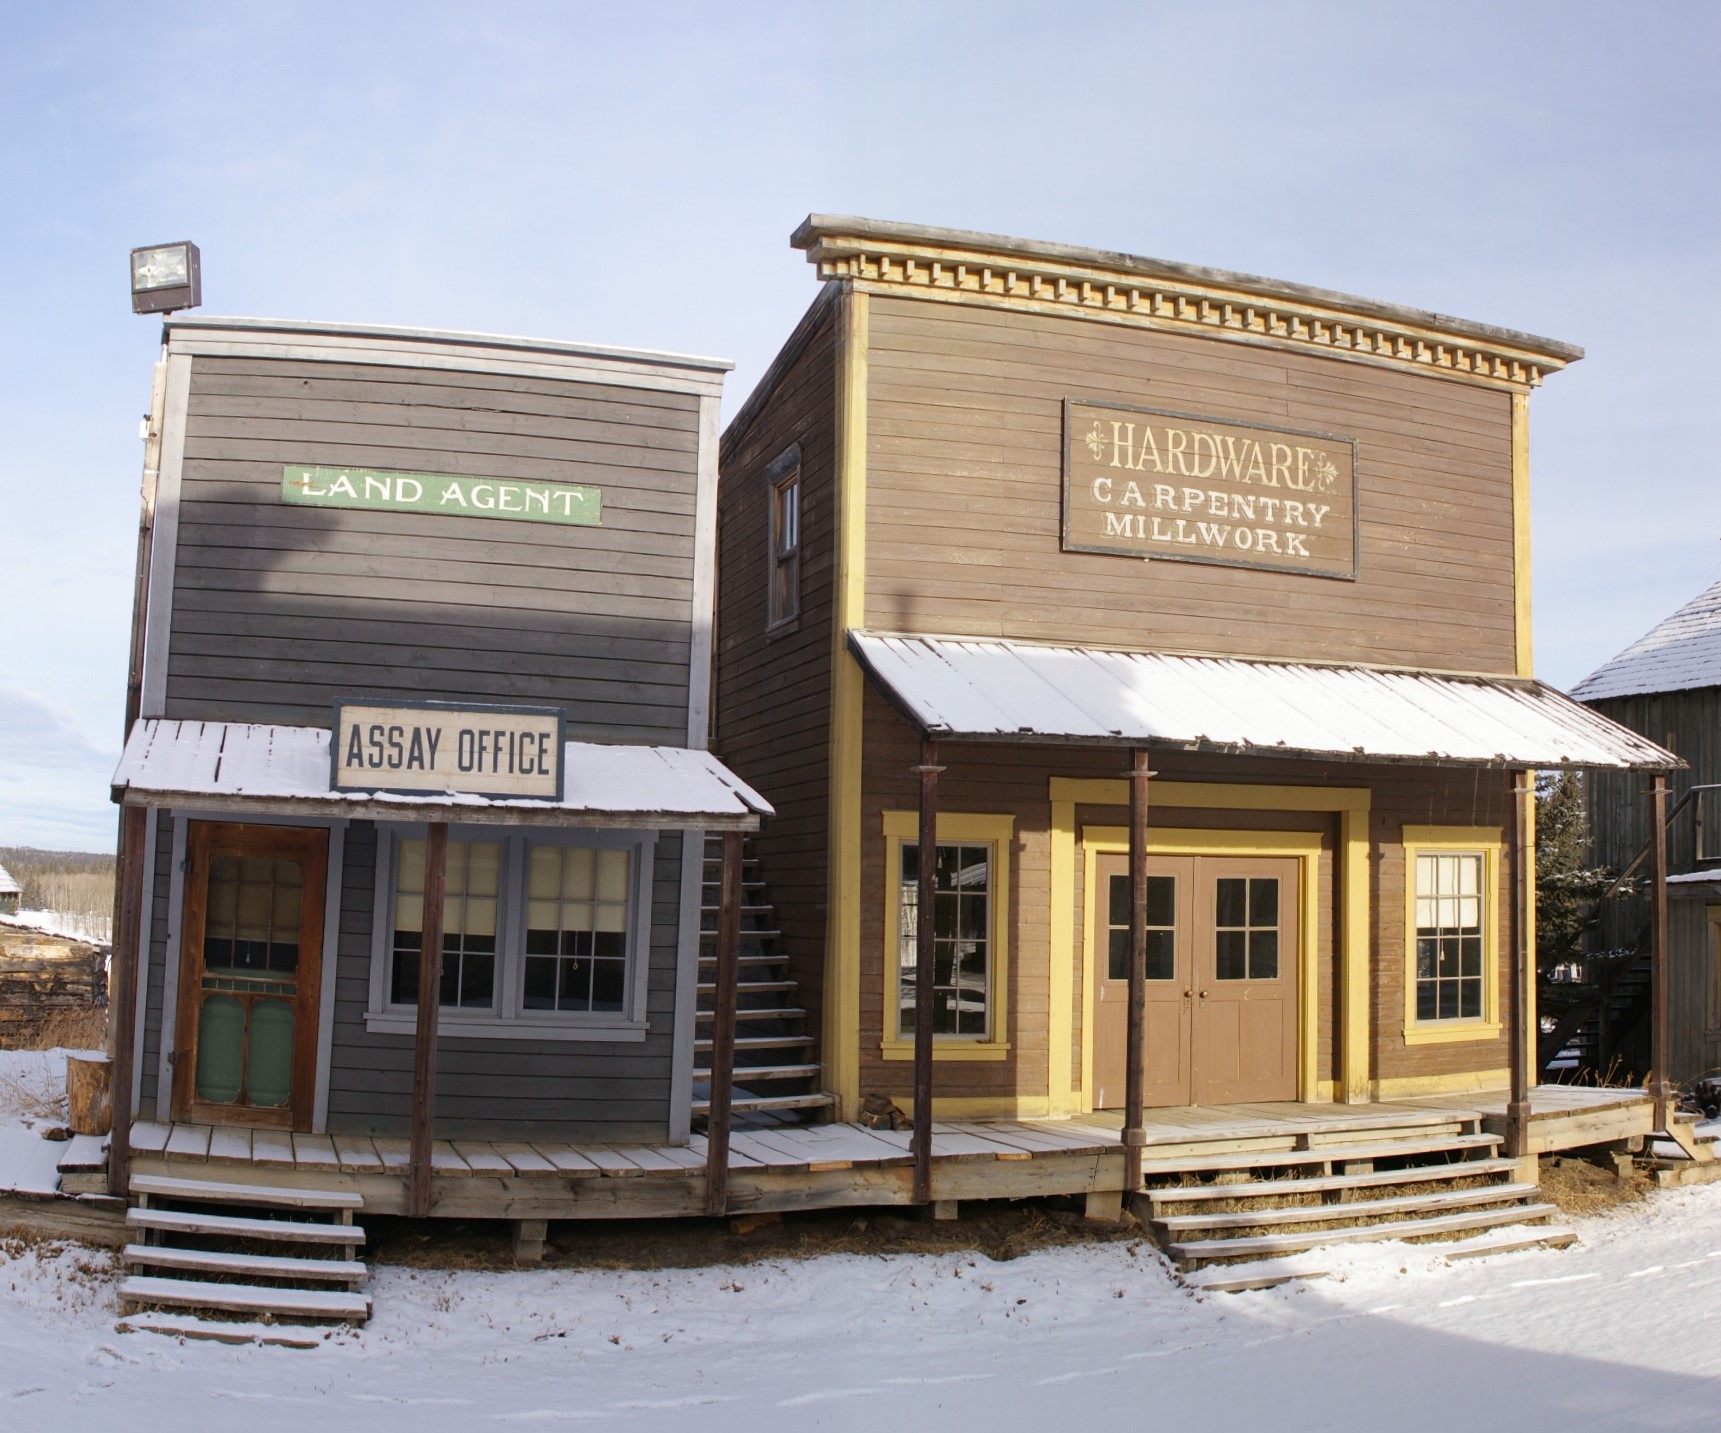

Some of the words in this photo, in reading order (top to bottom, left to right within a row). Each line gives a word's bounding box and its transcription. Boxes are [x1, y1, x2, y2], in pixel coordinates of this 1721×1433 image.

[1109, 421, 1316, 491] HARDWARE
[301, 472, 423, 502] LAND
[439, 482, 583, 515] AGENT
[1092, 477, 1330, 528] CARPENTRY
[1103, 512, 1310, 557] MILLWORK
[346, 724, 442, 770] ASSAY
[458, 729, 550, 775] OFFICE
